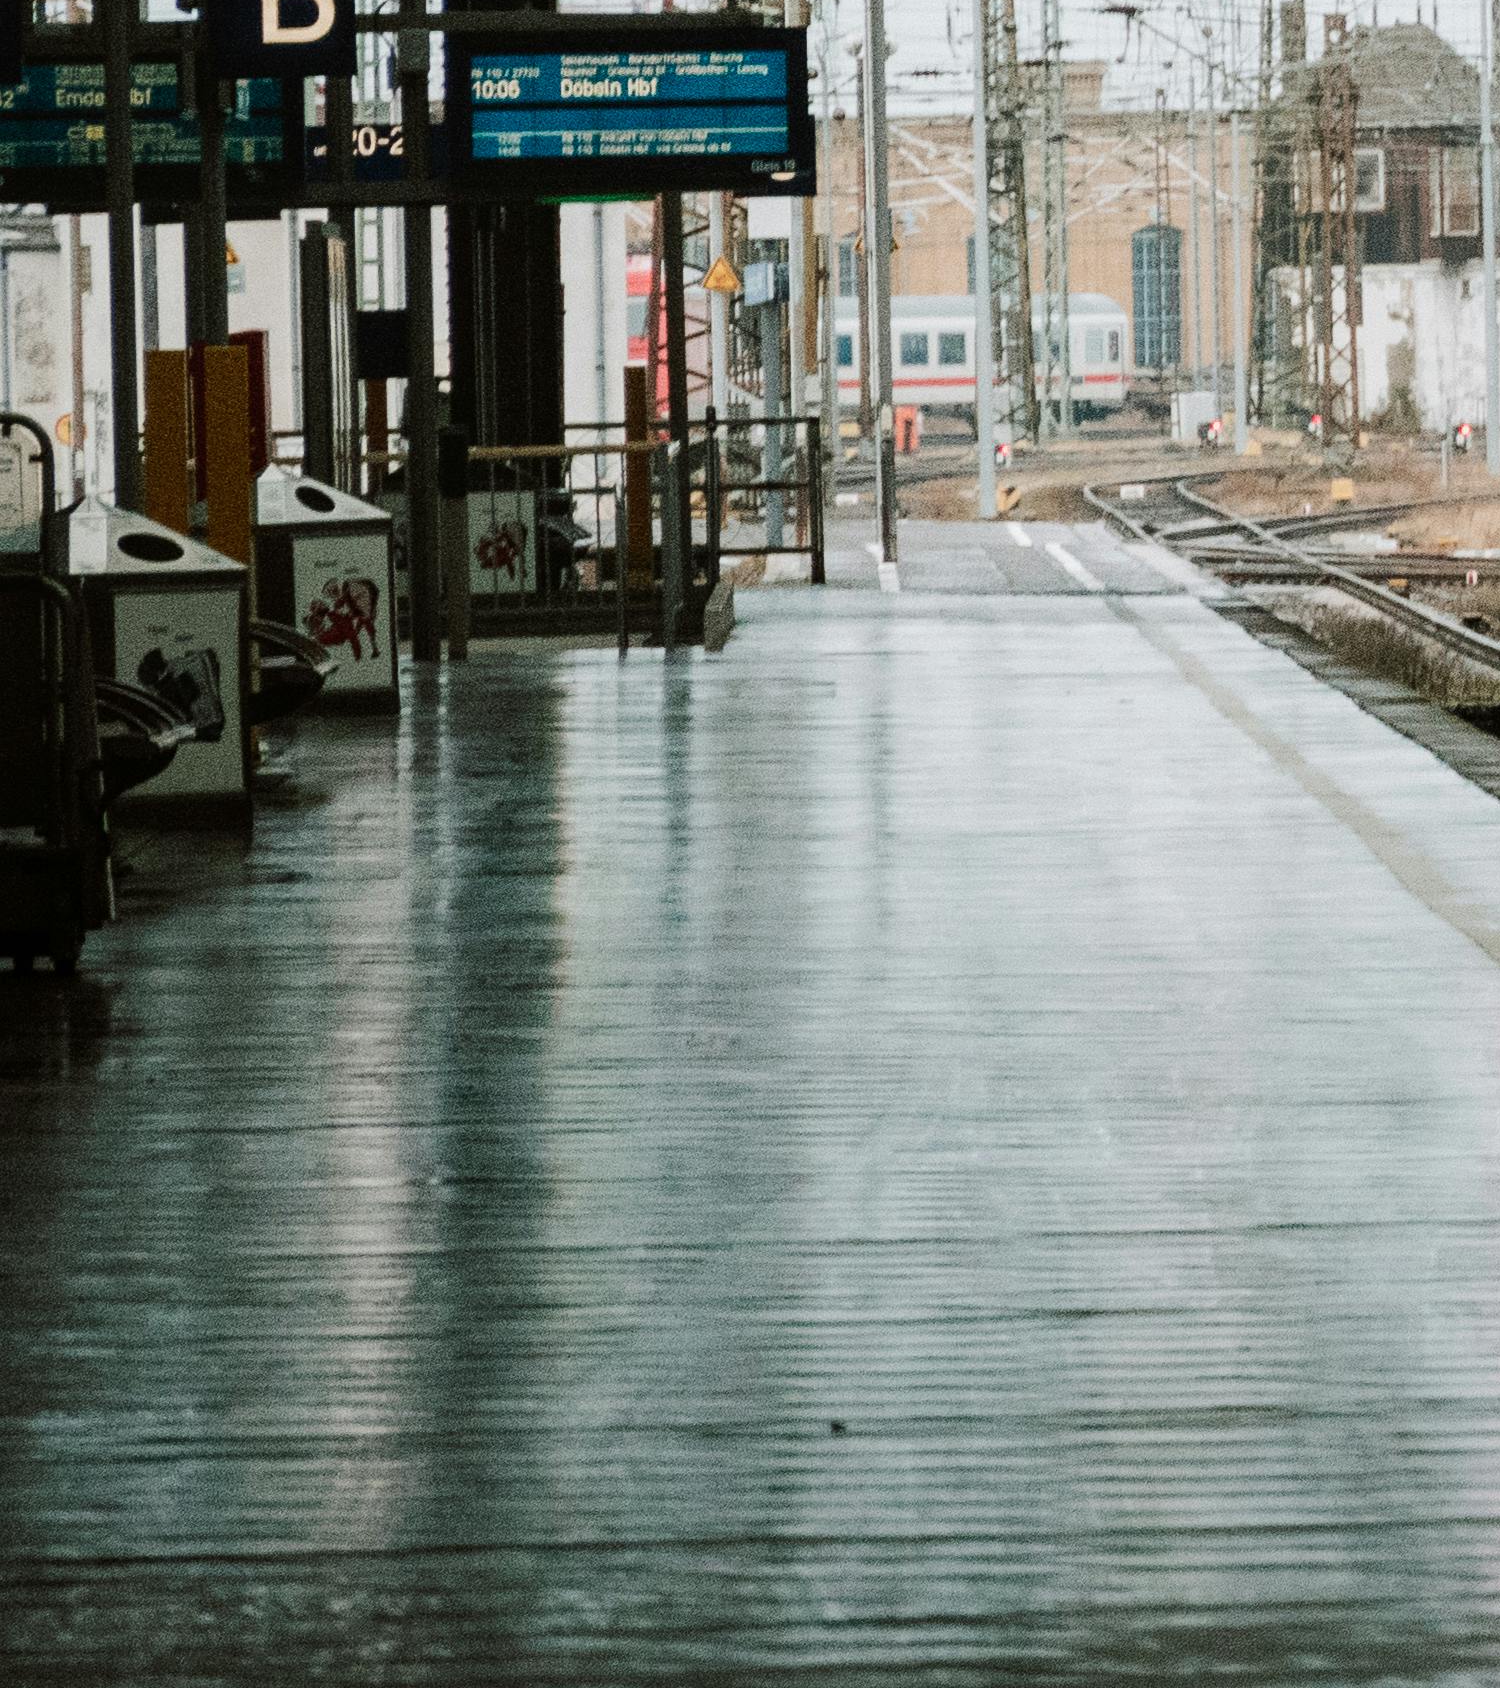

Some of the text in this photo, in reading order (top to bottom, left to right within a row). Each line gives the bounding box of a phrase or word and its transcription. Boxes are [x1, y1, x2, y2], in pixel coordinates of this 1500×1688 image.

[472, 80, 520, 99] 10:06
[561, 76, 657, 97] Döbeln Hbf
